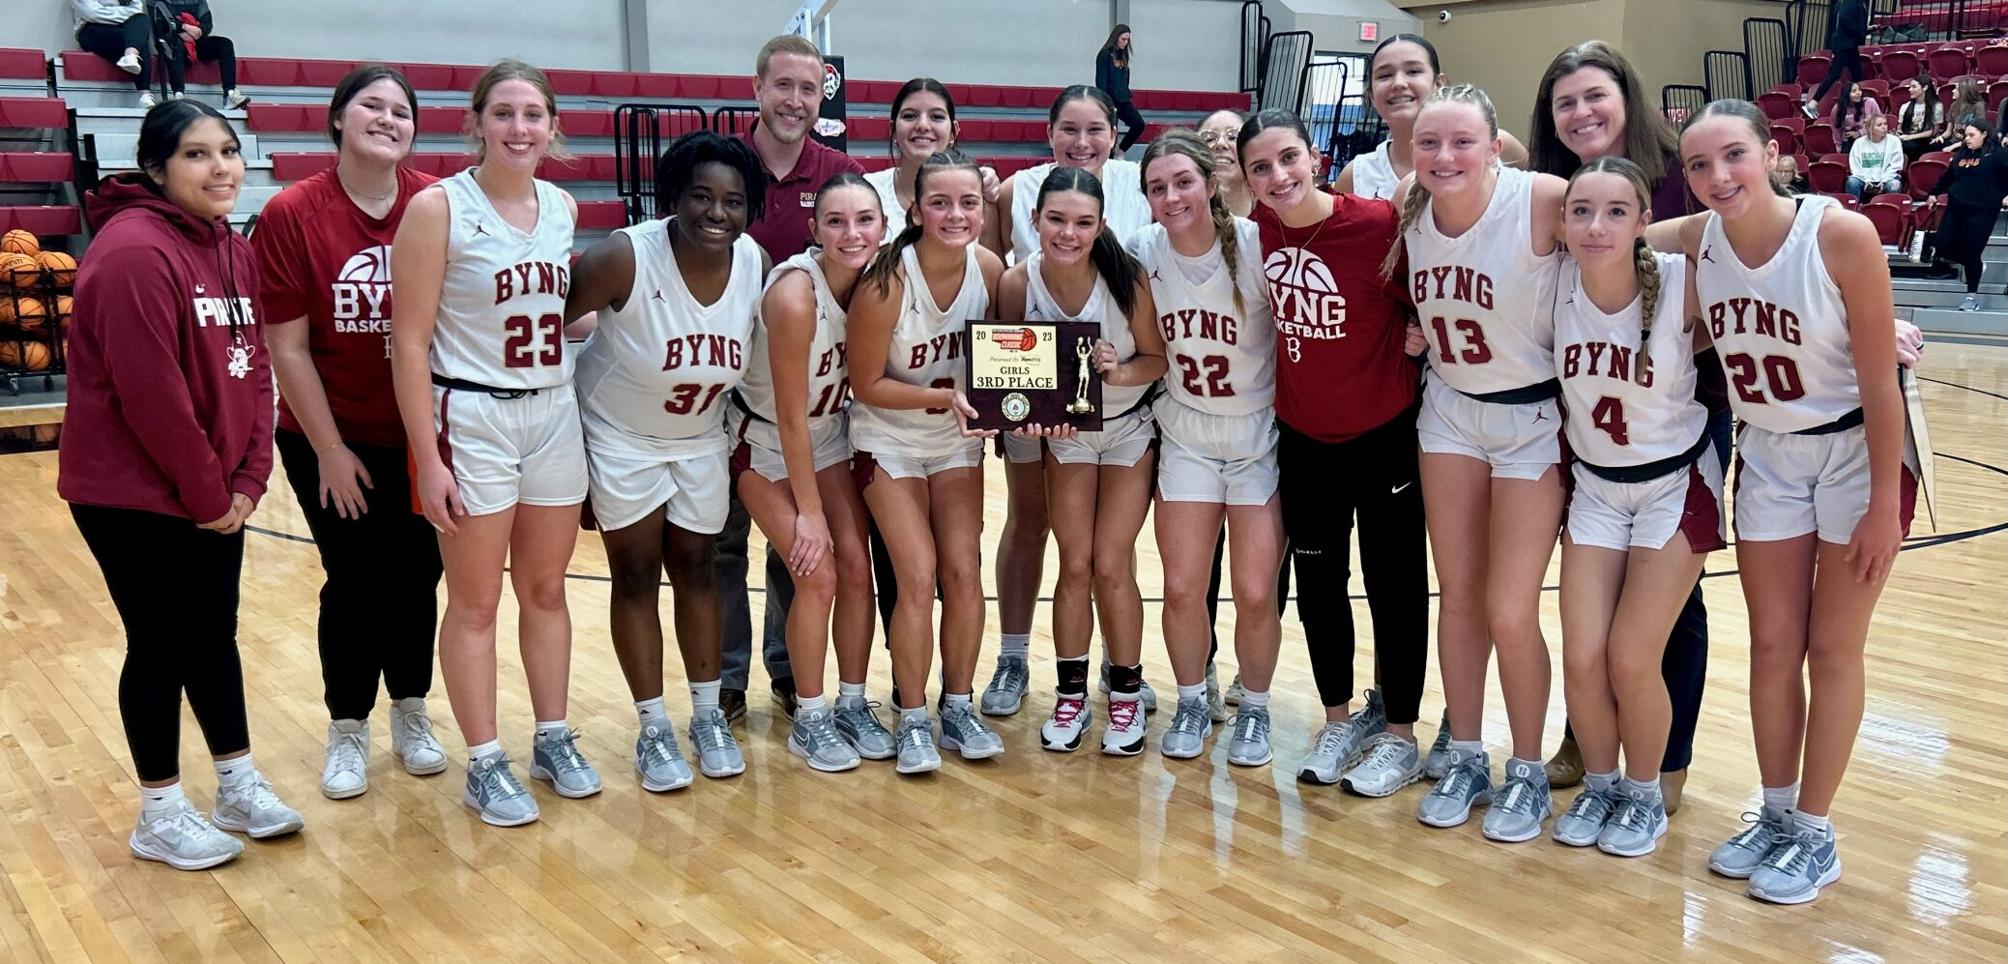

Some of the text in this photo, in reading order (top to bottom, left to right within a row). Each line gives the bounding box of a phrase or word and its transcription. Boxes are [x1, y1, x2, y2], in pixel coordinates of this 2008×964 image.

[331, 283, 392, 318] BY
[495, 261, 568, 305] BYNG
[1414, 266, 1493, 310] BYNG
[1267, 282, 1346, 326] YNG
[1709, 298, 1801, 345] BYNG
[335, 320, 392, 333] BASKE
[505, 314, 562, 367] 23
[976, 331, 986, 340] 20
[1042, 332, 1052, 341] 23
[1161, 309, 1236, 346] BYNG
[1274, 316, 1346, 340] KETBALL
[1432, 317, 1492, 364] 13
[662, 334, 741, 371] BYNG
[816, 342, 848, 377] BY
[909, 331, 966, 369] BYN
[977, 377, 1053, 388] 3RD PLACE
[1000, 366, 1030, 375] GIRLS
[1176, 354, 1236, 397] 22
[1725, 353, 1805, 404] 20
[665, 384, 725, 415] 31
[1592, 396, 1629, 445] 4
